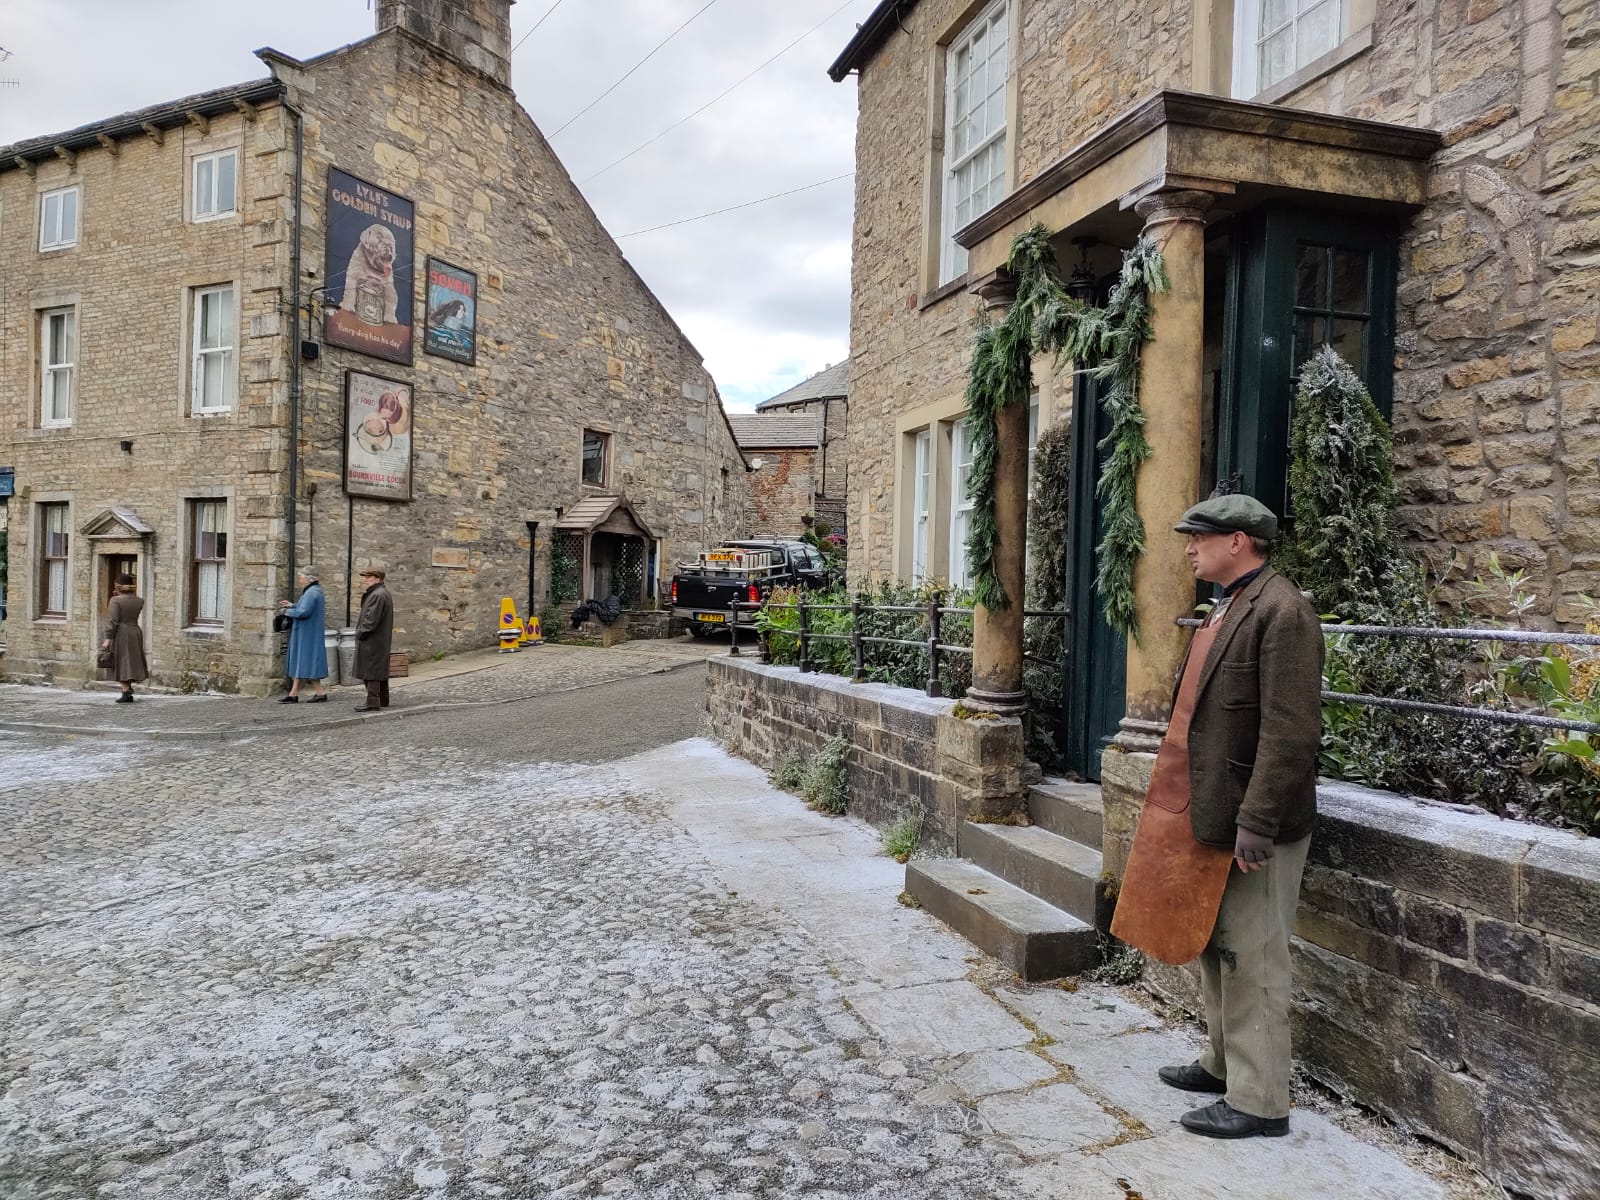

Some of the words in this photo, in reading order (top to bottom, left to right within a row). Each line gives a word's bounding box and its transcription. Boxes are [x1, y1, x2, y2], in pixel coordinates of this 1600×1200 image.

[332, 188, 377, 217] GOLDEN
[380, 208, 412, 230] SYRUP
[356, 329, 368, 340] dog
[369, 332, 380, 341] has
